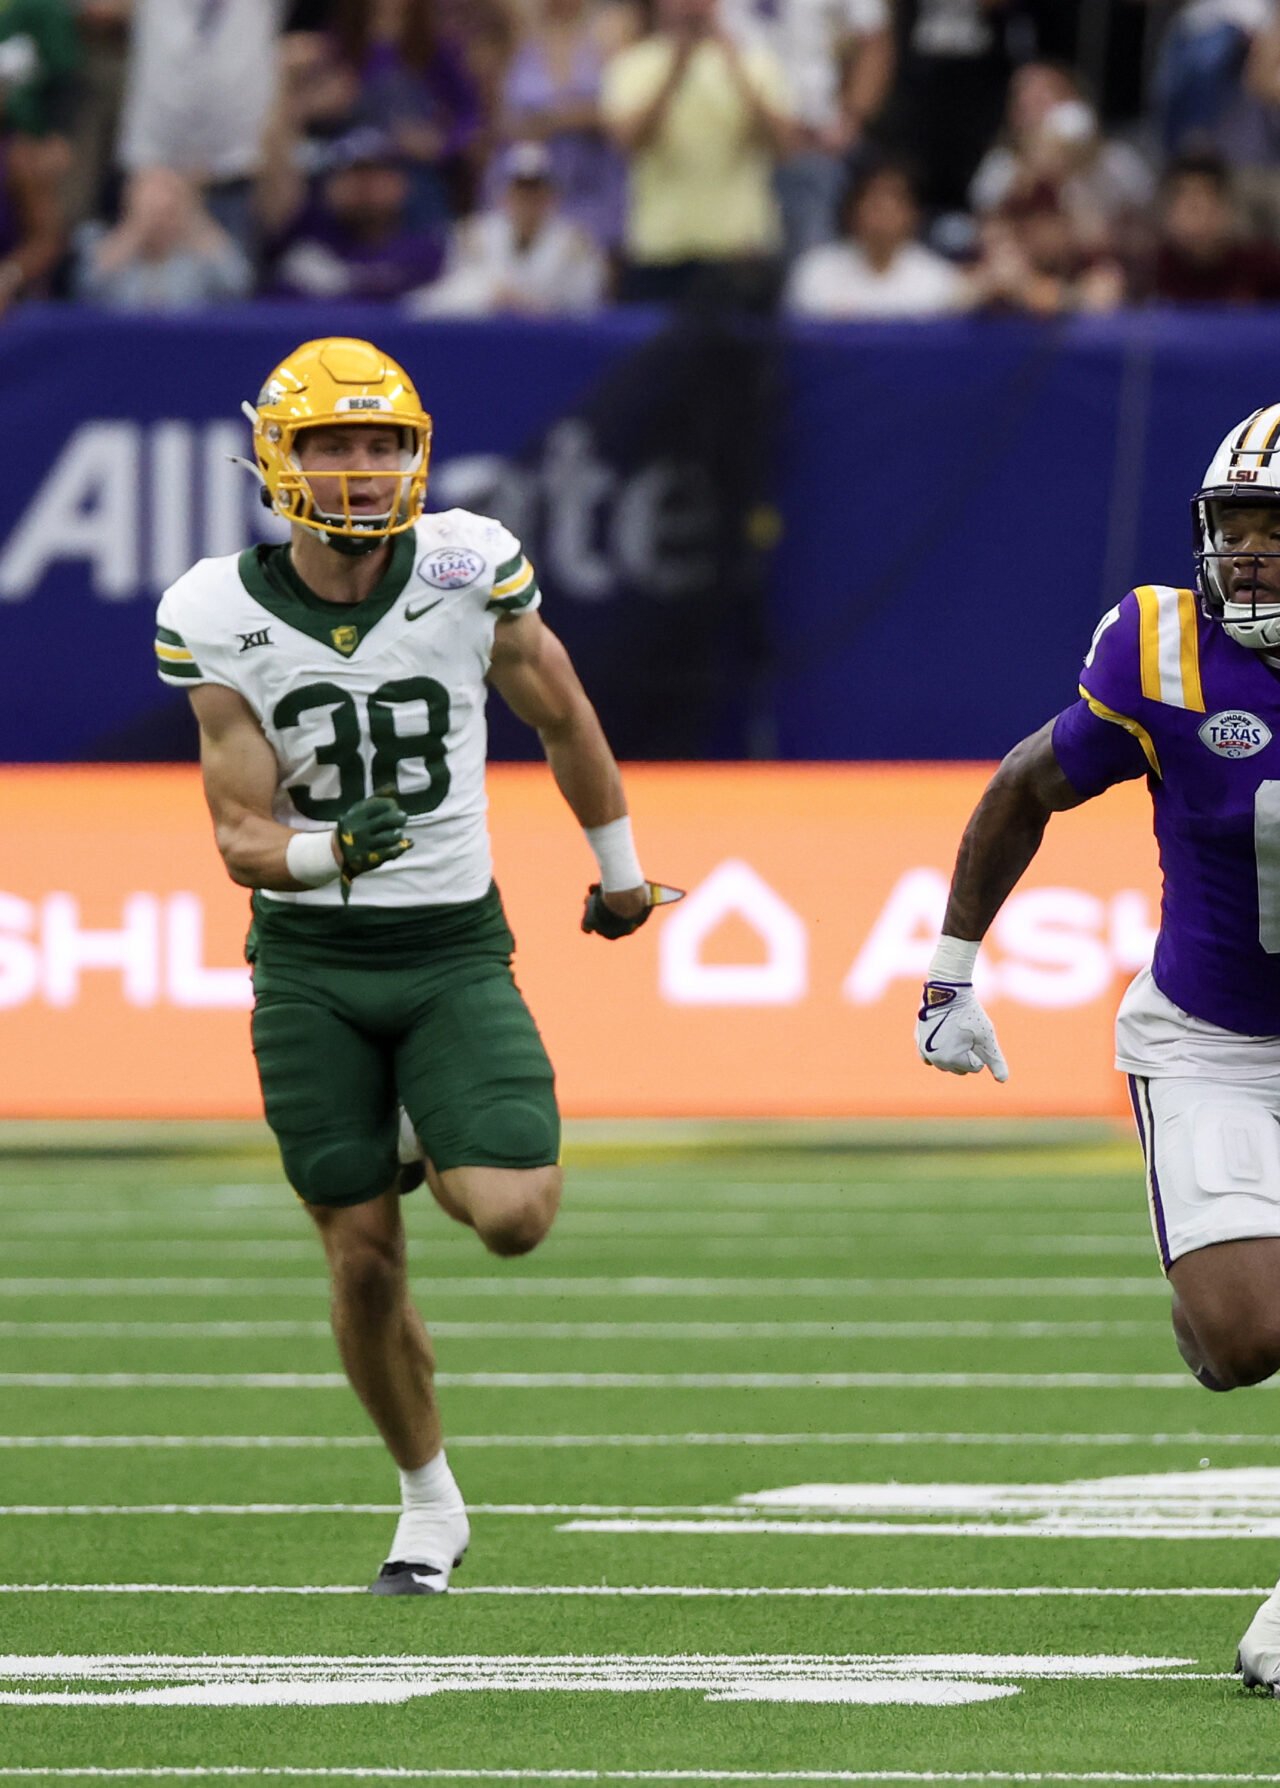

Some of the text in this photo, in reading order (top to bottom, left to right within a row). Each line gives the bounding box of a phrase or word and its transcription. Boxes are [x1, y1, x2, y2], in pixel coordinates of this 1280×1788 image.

[1227, 469, 1258, 483] LSU
[0, 415, 722, 602] Allte
[430, 558, 476, 578] TEXAS
[235, 626, 275, 653] XII
[1209, 726, 1260, 745] TEXAS
[272, 676, 450, 821] 38
